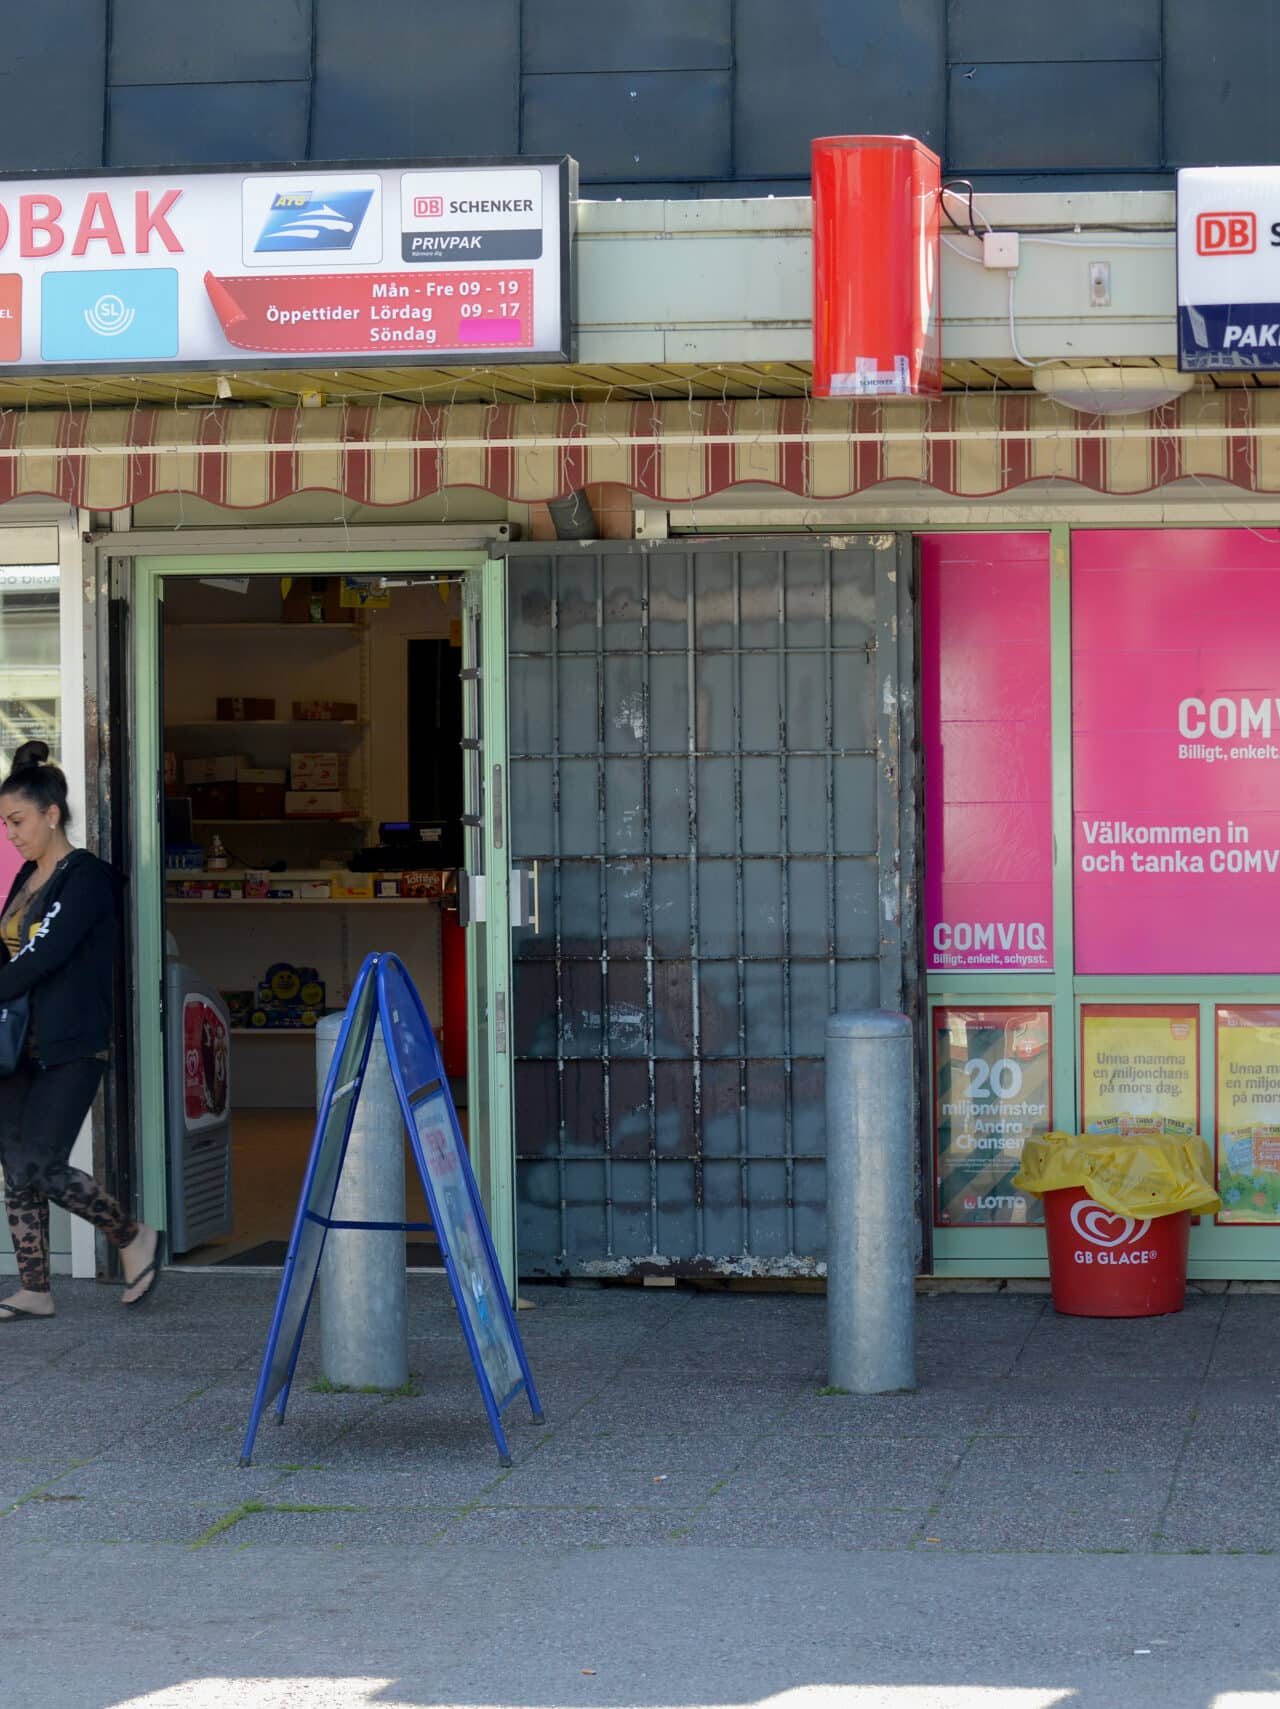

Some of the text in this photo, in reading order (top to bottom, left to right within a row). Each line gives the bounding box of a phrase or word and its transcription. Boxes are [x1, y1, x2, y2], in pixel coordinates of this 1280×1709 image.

[417, 199, 534, 214] DB SCHENKER
[1204, 219, 1249, 249] DB
[412, 236, 482, 250] PRIVPAK
[372, 283, 410, 298] Mån
[427, 283, 454, 297] Fre
[459, 281, 481, 296] 09
[498, 280, 519, 295] 19
[101, 303, 119, 316] SL
[266, 305, 360, 325] Öppettider
[371, 305, 433, 322] Lördag
[461, 303, 482, 318] 09
[499, 302, 520, 317] 17
[370, 327, 437, 344] Söndag
[1178, 744, 1228, 762] Billigt,
[1082, 820, 1249, 844] Välkommen in
[1081, 850, 1125, 873] och
[1131, 850, 1204, 873] tanka
[933, 922, 1047, 950] COMVIQ
[933, 953, 1048, 966] Billigt, enkelt, schysst.
[1096, 1052, 1186, 1065] Unna mamma
[1093, 1067, 1189, 1082] en miljonchans
[1229, 1062, 1262, 1074] Unna
[963, 1057, 1022, 1098] 20
[1225, 1079, 1241, 1089] en
[1099, 1081, 1115, 1097] på
[1119, 1083, 1152, 1093] mors
[1232, 1091, 1247, 1107] på
[942, 1101, 1045, 1119] miljonvinster
[974, 1120, 1024, 1133] Andra
[977, 1196, 1026, 1209] LOTTO
[1074, 1251, 1093, 1264] GB
